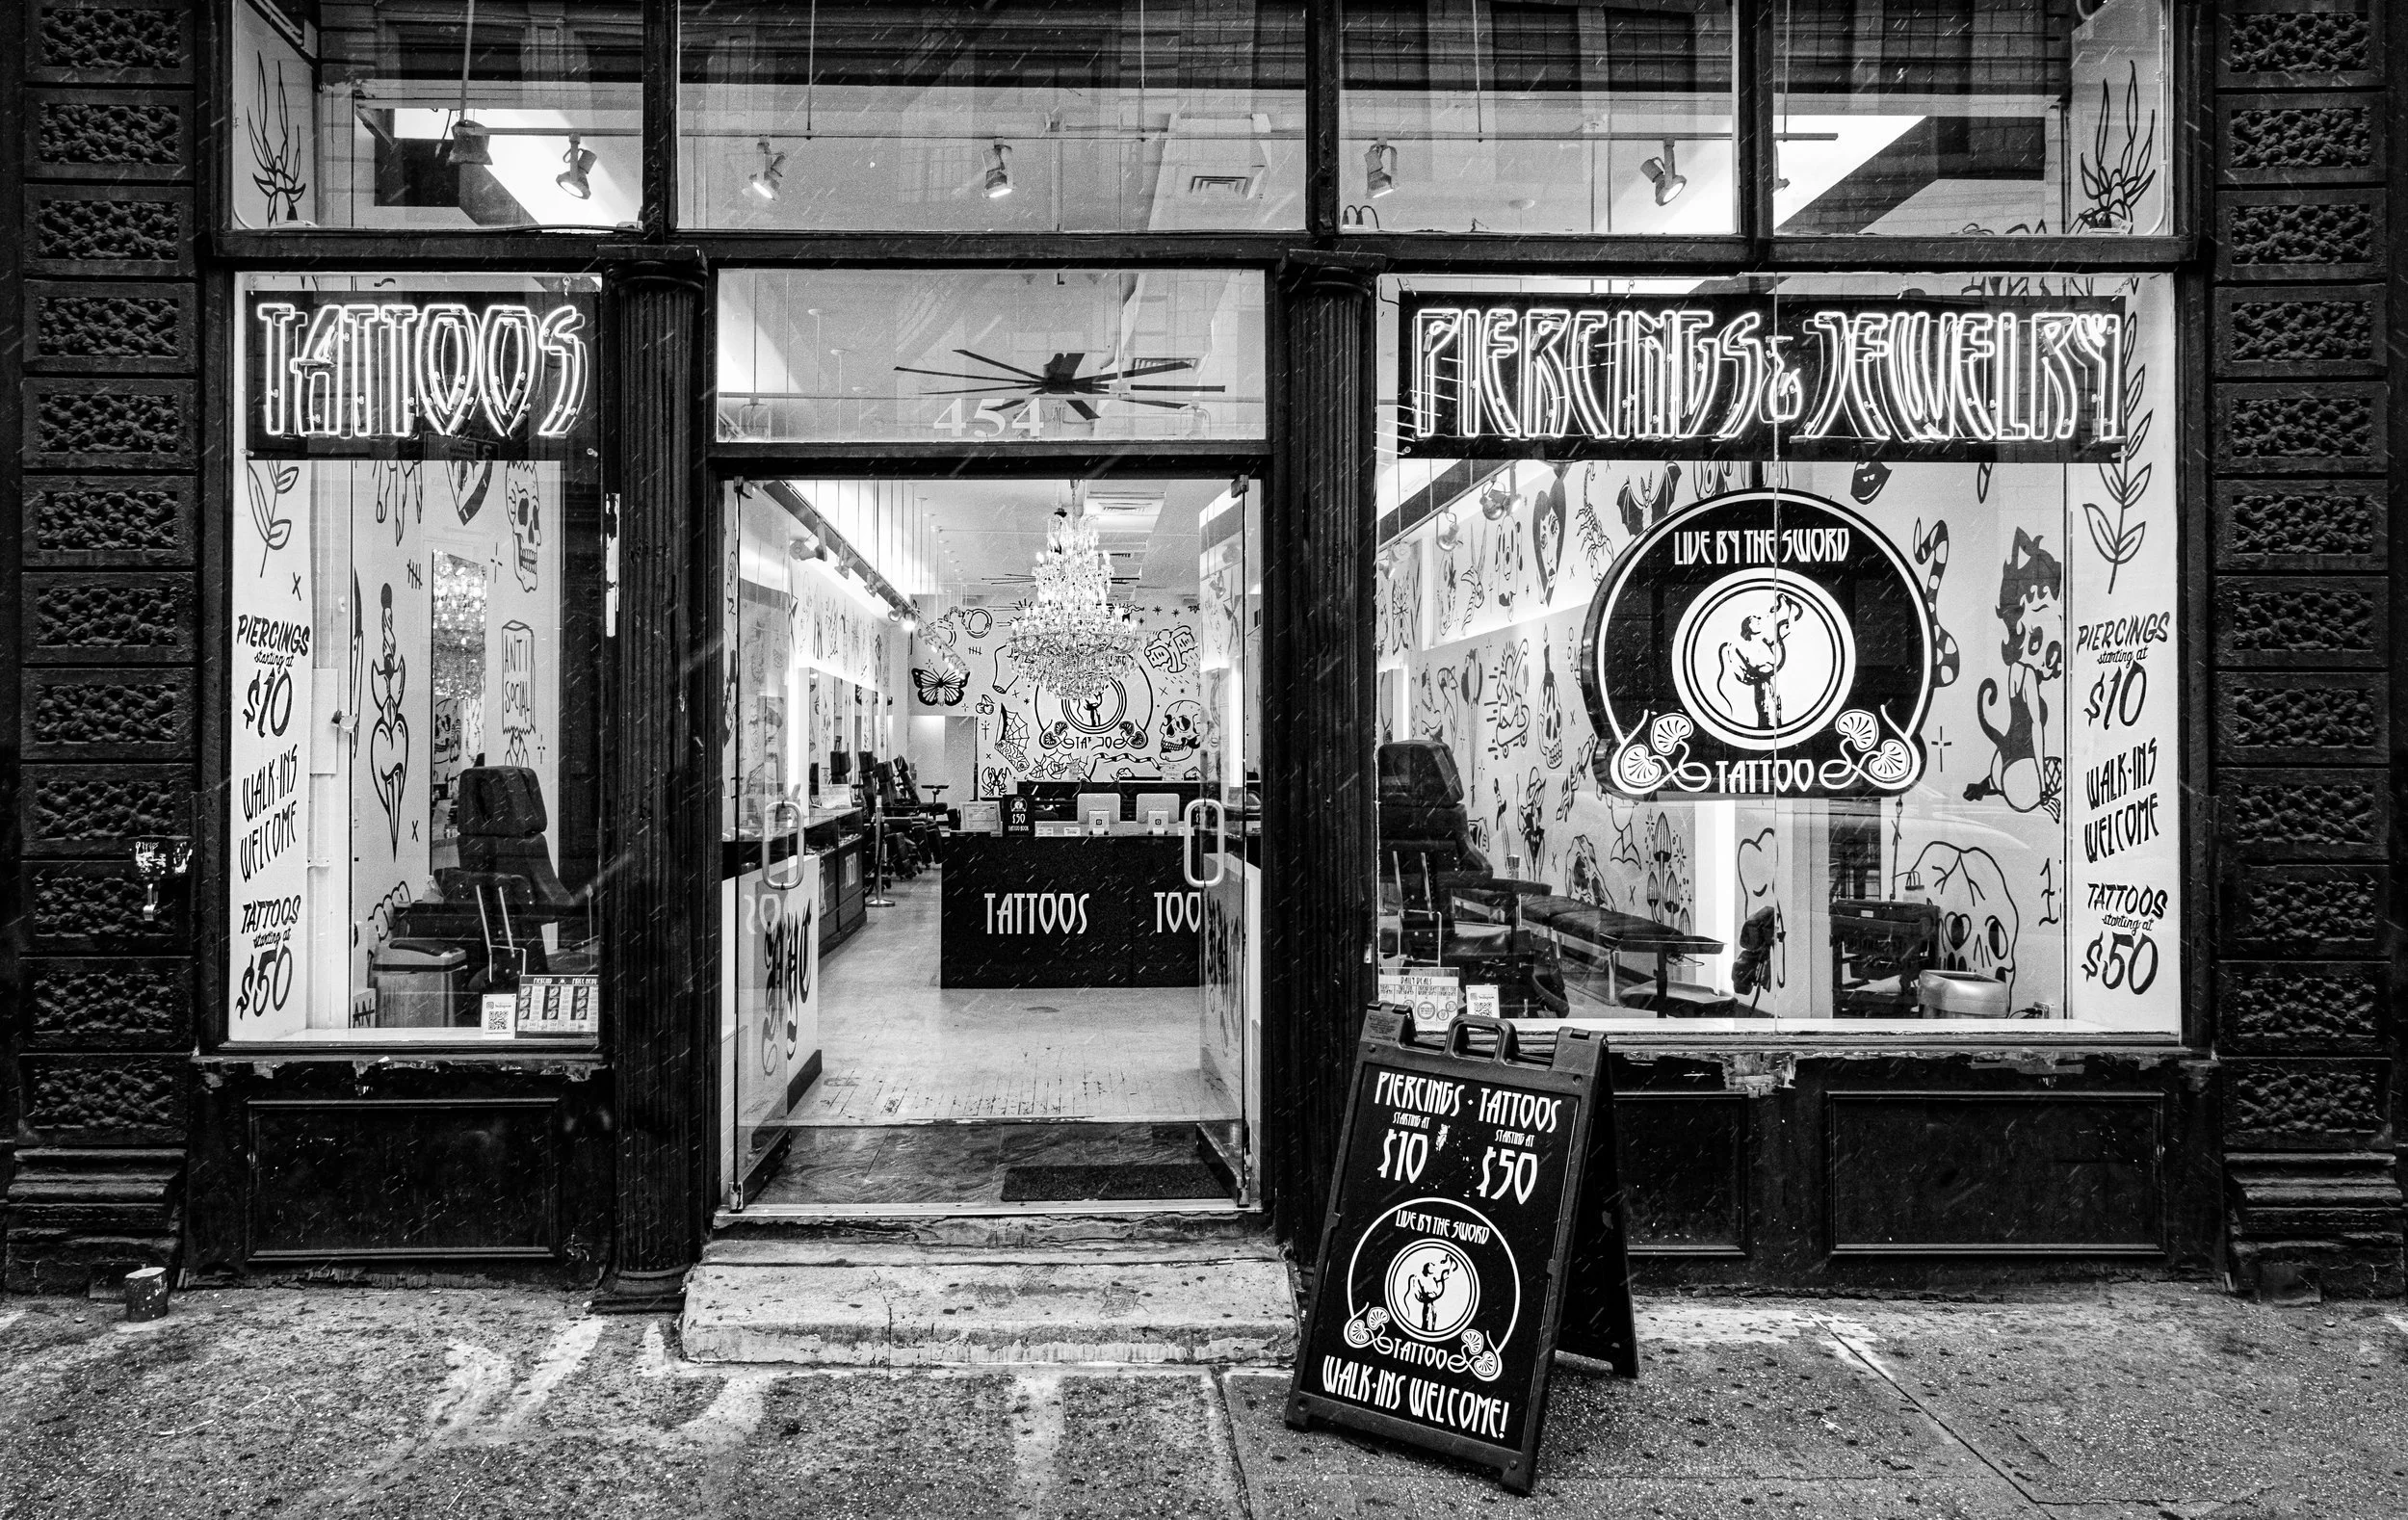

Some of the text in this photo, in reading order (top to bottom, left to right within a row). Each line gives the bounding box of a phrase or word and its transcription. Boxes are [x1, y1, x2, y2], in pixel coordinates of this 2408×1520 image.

[257, 304, 578, 436] TATTOOS
[1416, 308, 1761, 438] PIERCINGS
[1804, 311, 2120, 442] JEWELRY
[933, 398, 1044, 437] 454
[1674, 528, 1850, 565] LIVE BY THE SWORD
[236, 614, 310, 659] PIERCINGS
[504, 634, 528, 673] ANTI
[2076, 612, 2170, 655] PIERCINGS
[254, 650, 295, 675] starting at
[2097, 646, 2149, 671] starting at
[243, 668, 293, 738] $10
[2083, 659, 2148, 730] $10
[1715, 759, 1815, 794] TATTOO
[240, 799, 297, 882] WELCOME
[2083, 793, 2160, 863] WELCOME
[241, 894, 301, 936] TATTOOS
[984, 893, 1089, 934] TATTOOS
[2087, 883, 2168, 920] TATTOOS
[253, 930, 281, 950] starting
[2102, 915, 2140, 936] starting
[236, 945, 293, 1021] $50
[2081, 930, 2159, 995] $50
[1374, 1071, 1561, 1133] PIERCINGS TATTOOS
[1393, 1112, 1430, 1130] STARTING AT
[1377, 1128, 1428, 1184] $10
[1495, 1129, 1535, 1147] STARTING AT
[1476, 1146, 1538, 1205] $50
[1396, 1210, 1490, 1245] LIVE BY THE SWORD
[1394, 1337, 1448, 1370] TATTOO
[1408, 1377, 1509, 1439] WELCOME!
